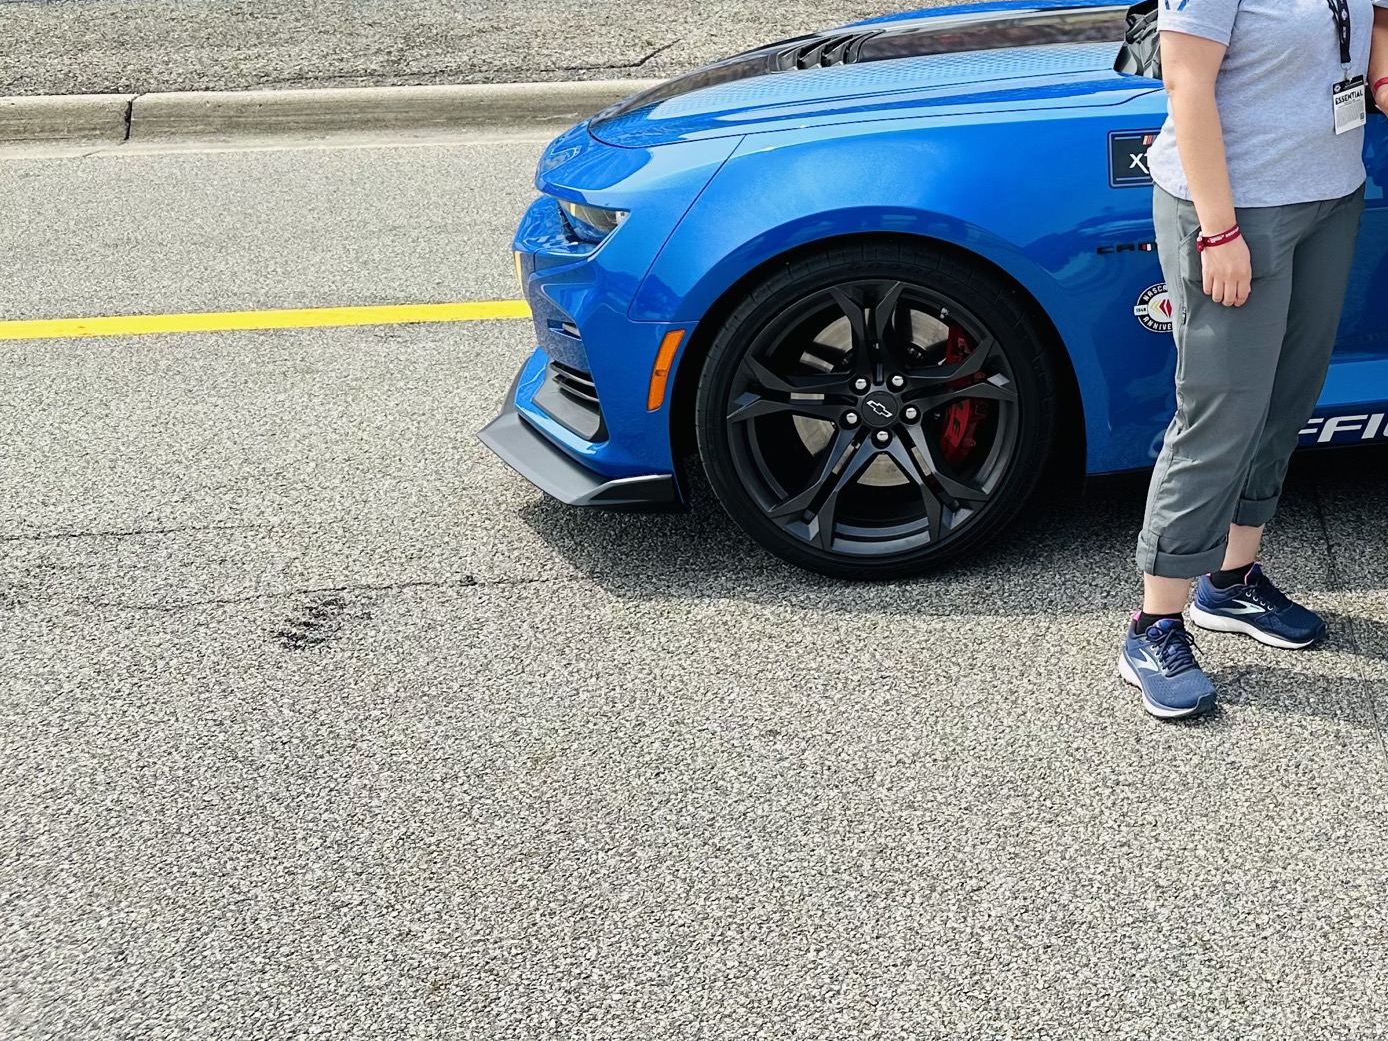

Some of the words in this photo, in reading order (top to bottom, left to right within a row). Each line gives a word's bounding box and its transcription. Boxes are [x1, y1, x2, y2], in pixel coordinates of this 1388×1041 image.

[1335, 90, 1364, 106] ESSENTIAL
[1129, 153, 1150, 174] X
[1143, 284, 1168, 301] NASCA
[1143, 317, 1173, 331] ANNIVE
